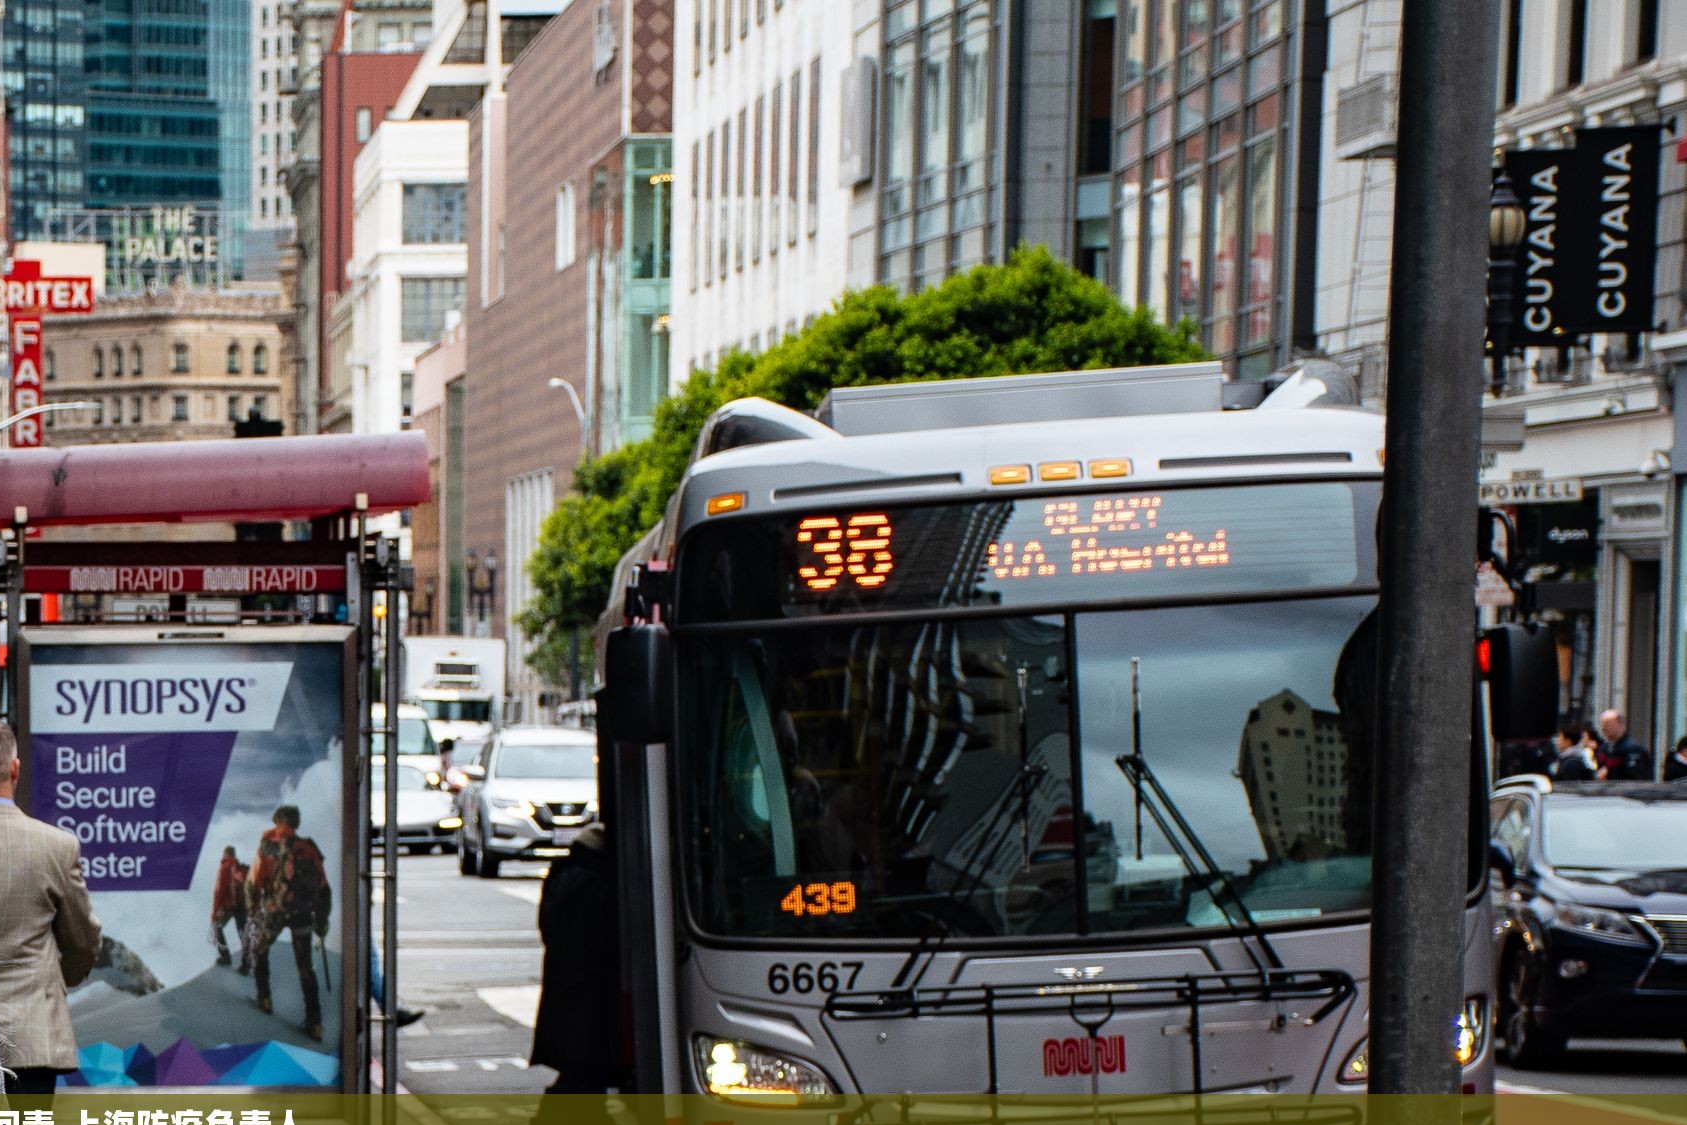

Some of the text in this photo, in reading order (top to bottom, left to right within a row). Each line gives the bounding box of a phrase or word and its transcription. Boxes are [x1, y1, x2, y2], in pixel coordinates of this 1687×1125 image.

[152, 206, 196, 232] THE
[1596, 142, 1632, 318] CUYANA
[127, 237, 218, 263] PALACE
[1523, 165, 1559, 333] CUYANA
[1480, 480, 1576, 499] POWELL
[797, 513, 894, 591] 38
[118, 566, 184, 592] RAPID
[252, 566, 317, 592] RAPID
[55, 744, 127, 775] Build
[55, 780, 156, 809] Secure
[79, 853, 147, 879] aster
[780, 881, 856, 916] 439
[766, 961, 864, 995] 6667
